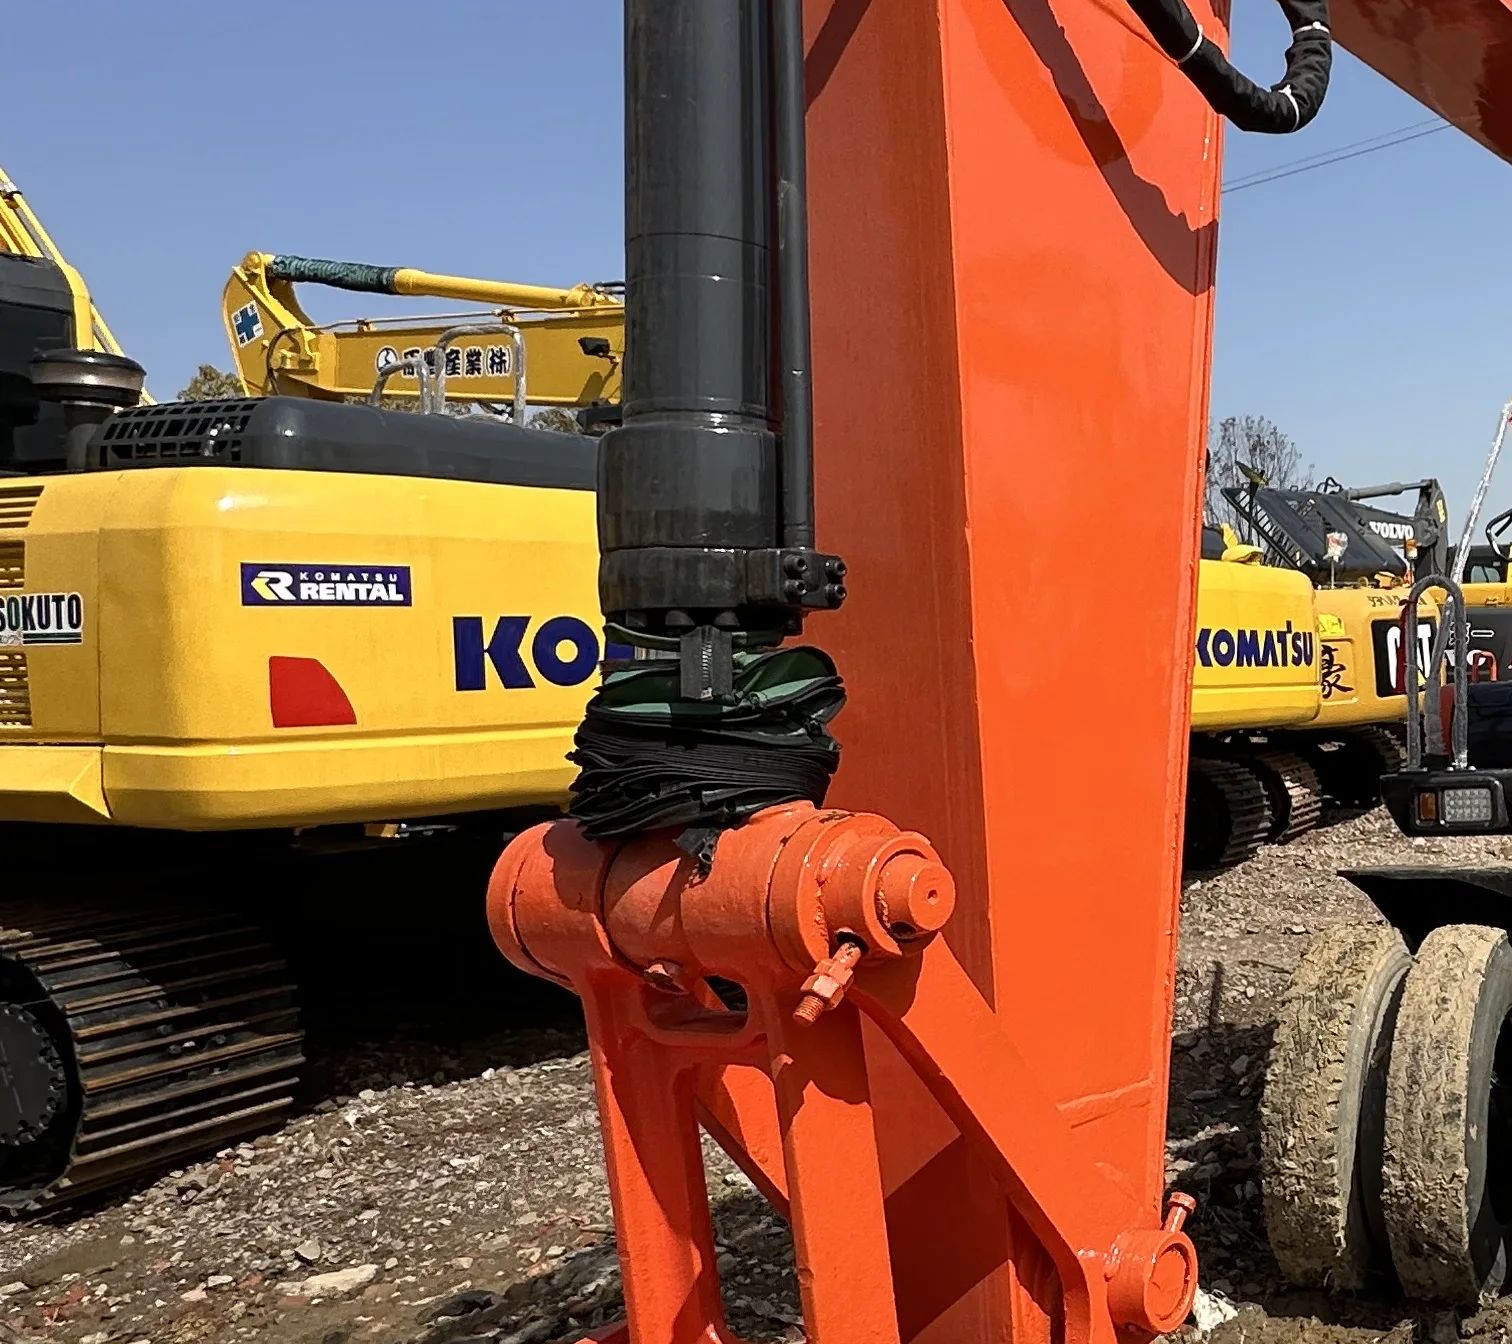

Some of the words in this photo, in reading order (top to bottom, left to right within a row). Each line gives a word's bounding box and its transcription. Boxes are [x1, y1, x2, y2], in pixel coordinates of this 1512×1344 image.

[1369, 521, 1415, 541] VOLVO
[300, 572, 398, 582] KOMATSU
[300, 583, 404, 601] RENTAL
